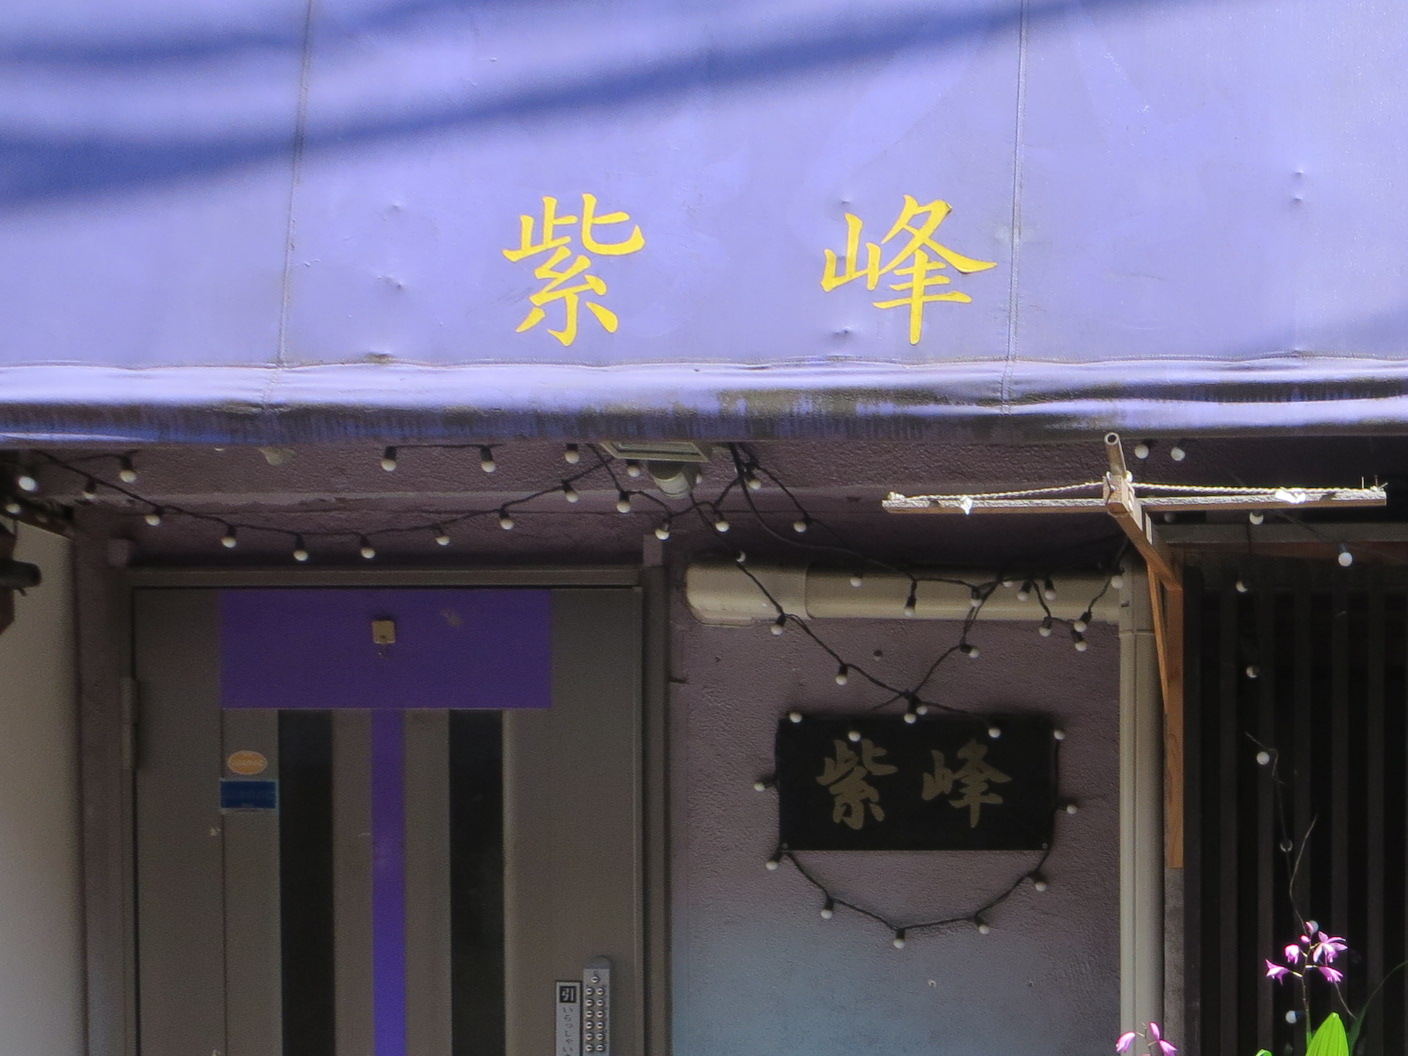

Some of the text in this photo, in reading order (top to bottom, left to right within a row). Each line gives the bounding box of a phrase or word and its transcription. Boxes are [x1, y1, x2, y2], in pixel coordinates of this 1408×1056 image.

[502, 193, 998, 347] 紫峰
[815, 738, 1012, 831] 紫峰
[561, 987, 575, 1002] 引
